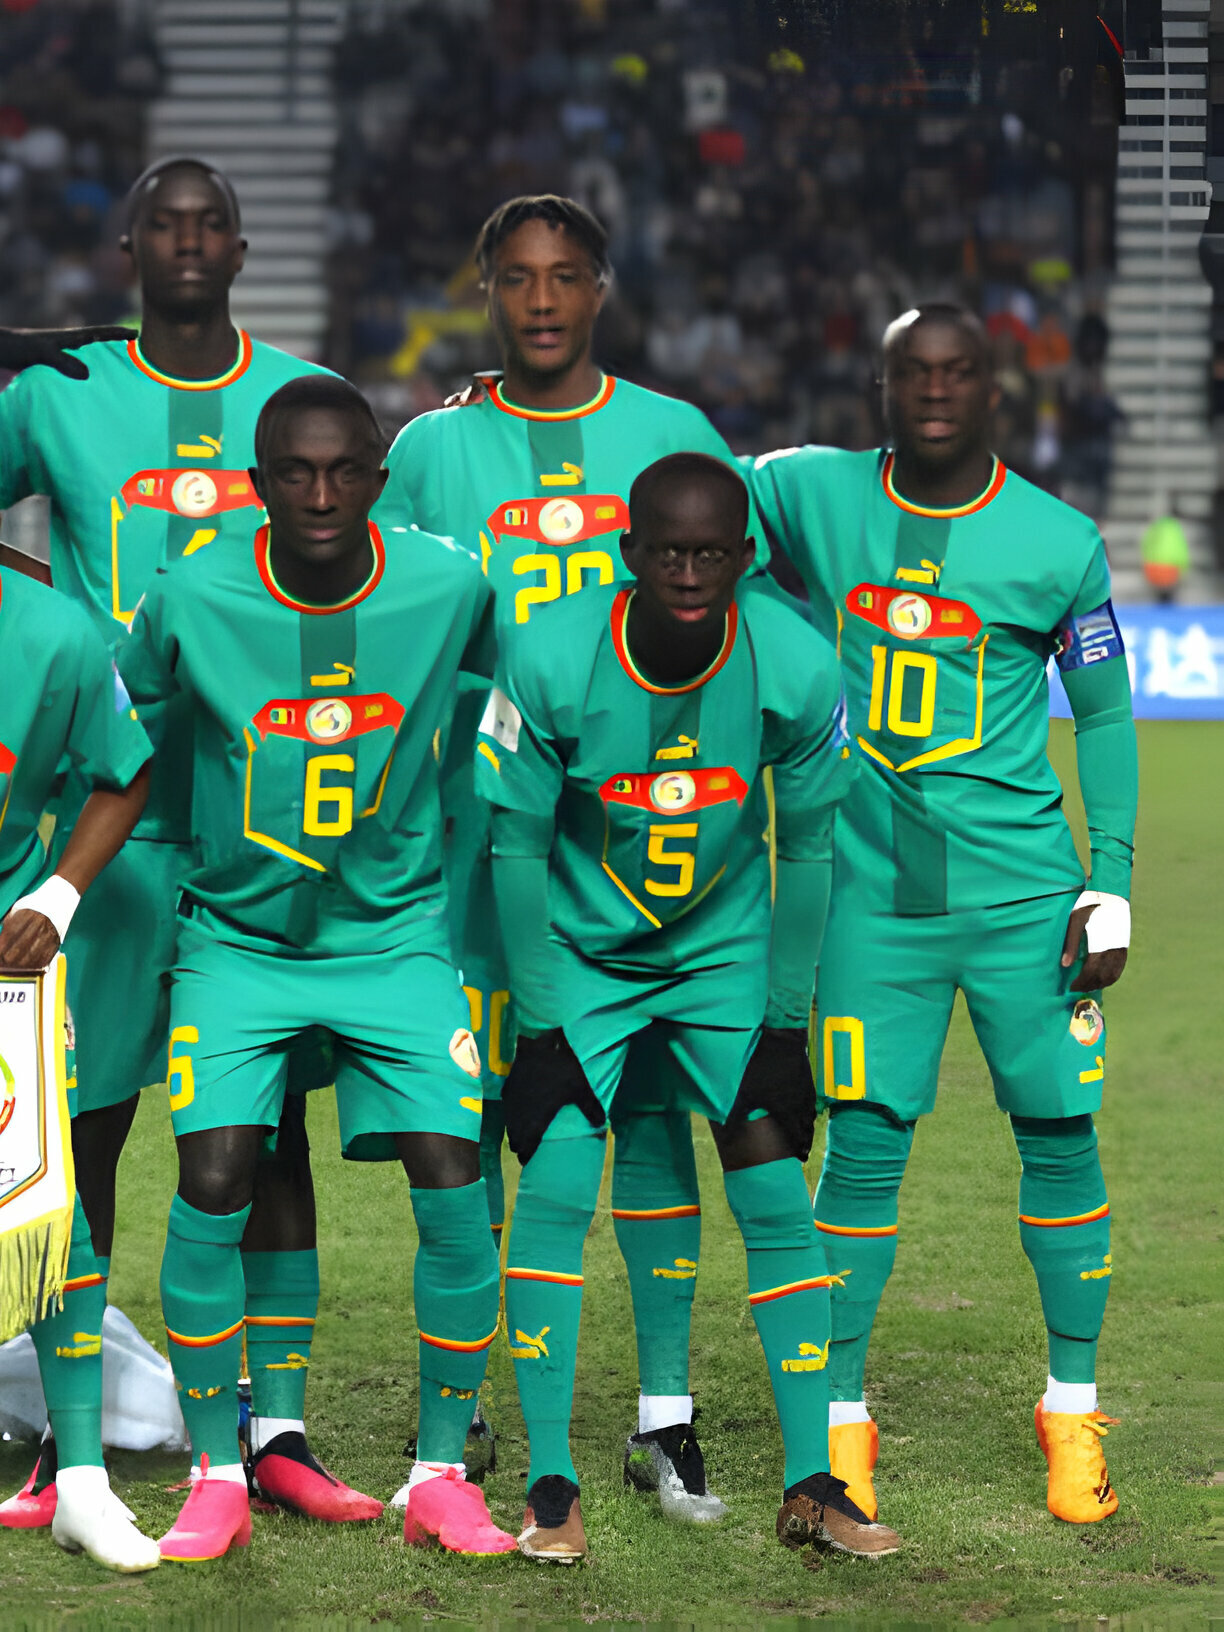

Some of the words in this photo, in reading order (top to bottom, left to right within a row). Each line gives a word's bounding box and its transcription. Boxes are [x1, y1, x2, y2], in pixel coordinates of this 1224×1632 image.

[868, 644, 937, 738] 10
[303, 753, 355, 837] 6
[644, 822, 699, 897] 5
